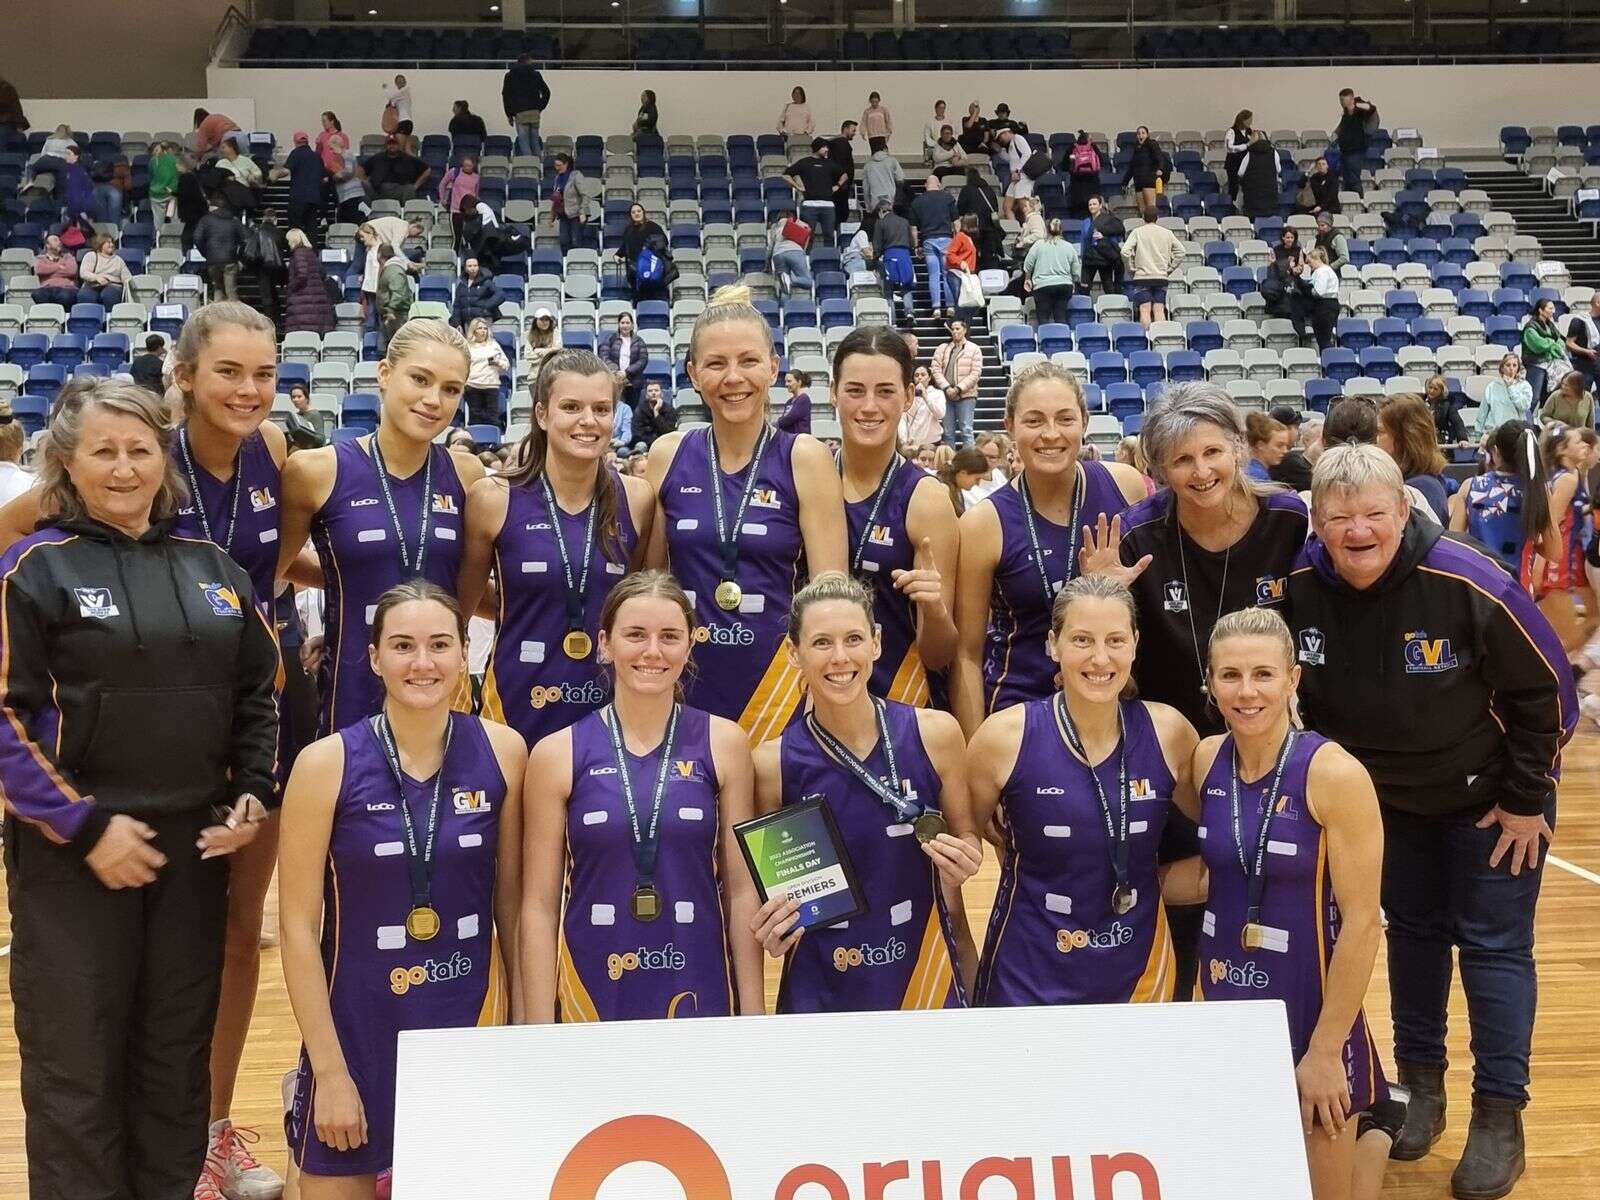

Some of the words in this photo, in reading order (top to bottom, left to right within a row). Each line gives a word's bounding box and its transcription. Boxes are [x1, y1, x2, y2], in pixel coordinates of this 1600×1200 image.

[711, 460, 719, 493] ASSOCIATION
[380, 477, 396, 514] ASSOCIATION
[422, 484, 430, 518] ASSOCIATION
[730, 517, 740, 542] NETBALL
[736, 493, 748, 518] VICTORIA
[743, 459, 759, 493] ASSOCIATION
[391, 514, 404, 540] VICTORIA
[548, 501, 562, 538] ASSOCIATION
[586, 506, 595, 542] ASSOCIATION
[718, 518, 726, 542] NETBALL
[859, 520, 872, 545] VICTORIA
[867, 486, 886, 521] ASSOCIATION
[419, 519, 427, 544] VICTORIA
[1026, 514, 1039, 549] ASSOCIATION
[414, 546, 424, 571] NETBALL
[557, 537, 569, 563] VICTORIA
[582, 542, 591, 567] VICTORIA
[1034, 549, 1045, 574] VICTORIA
[1066, 545, 1074, 570] VICTORIA
[578, 568, 587, 593] NETBALL
[694, 622, 755, 645] otafe
[1404, 639, 1457, 667] GVL
[530, 680, 604, 709] gotafe
[616, 748, 629, 786] ASSOCIATION
[833, 744, 865, 774] ASSOCIATION
[887, 749, 899, 790] ASSOCIATION
[648, 809, 658, 838] NETBALL
[653, 781, 664, 810] VICTORIA
[659, 744, 672, 781] ASSOCIATION
[863, 771, 886, 793] VICTORIA
[1265, 776, 1280, 817] ASSOCIATION
[625, 785, 636, 813] VICTORIA
[884, 791, 907, 809] NETBALL
[428, 802, 437, 832] VICTORIA
[631, 814, 641, 842] NETBALL
[1104, 810, 1115, 837] NETBALL
[407, 827, 417, 856] NETBALL
[1233, 818, 1241, 846] VICTORIA
[1258, 818, 1269, 847] VICTORIA
[424, 833, 433, 862] NETBALL
[775, 849, 816, 866] CHAMPIONSHIPS
[782, 841, 817, 856] ASSOCIATION
[1254, 848, 1263, 875] NETBALL
[776, 863, 805, 879] FINALS
[805, 857, 821, 868] DAY
[787, 878, 837, 901] REMIERS
[1056, 921, 1134, 953] gotafe
[607, 943, 686, 981] gotafe
[833, 936, 906, 972] gotafe
[390, 951, 472, 995] gotafe
[1209, 958, 1270, 989] gotafe
[293, 1056, 307, 1138] LLEY
